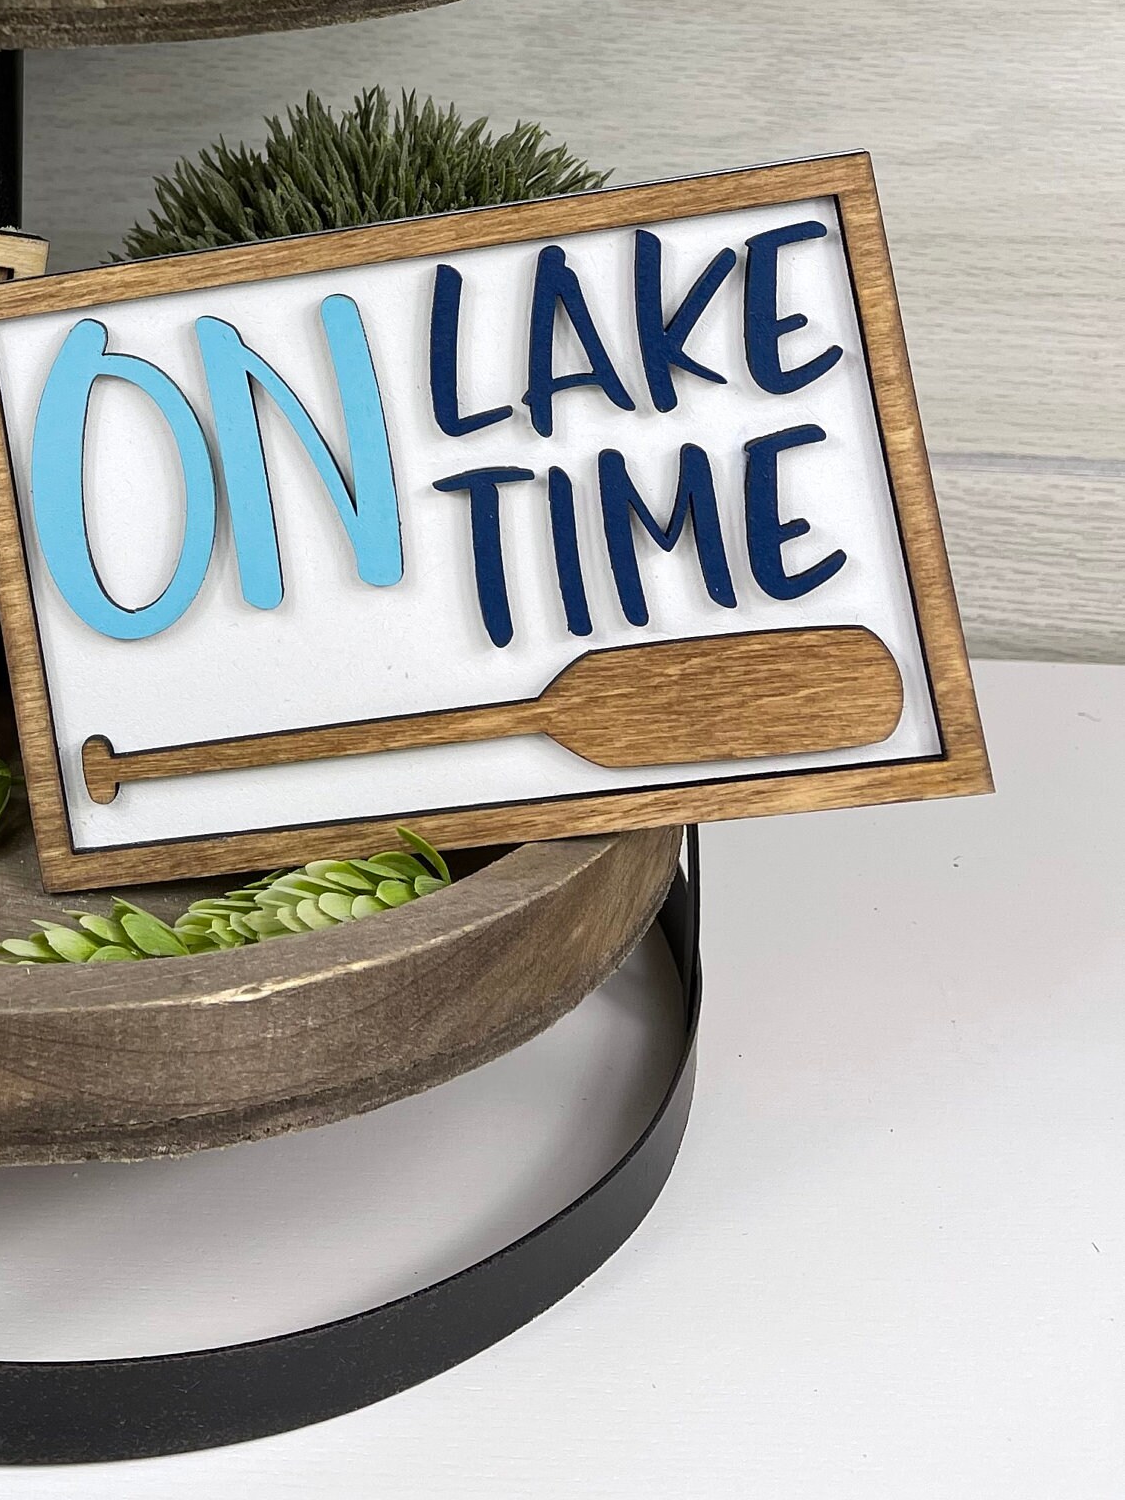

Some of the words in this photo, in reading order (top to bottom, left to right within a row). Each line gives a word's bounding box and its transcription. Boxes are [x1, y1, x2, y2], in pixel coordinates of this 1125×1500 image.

[429, 220, 844, 439] LAKE
[30, 293, 404, 641] ON
[431, 424, 849, 649] TIME
